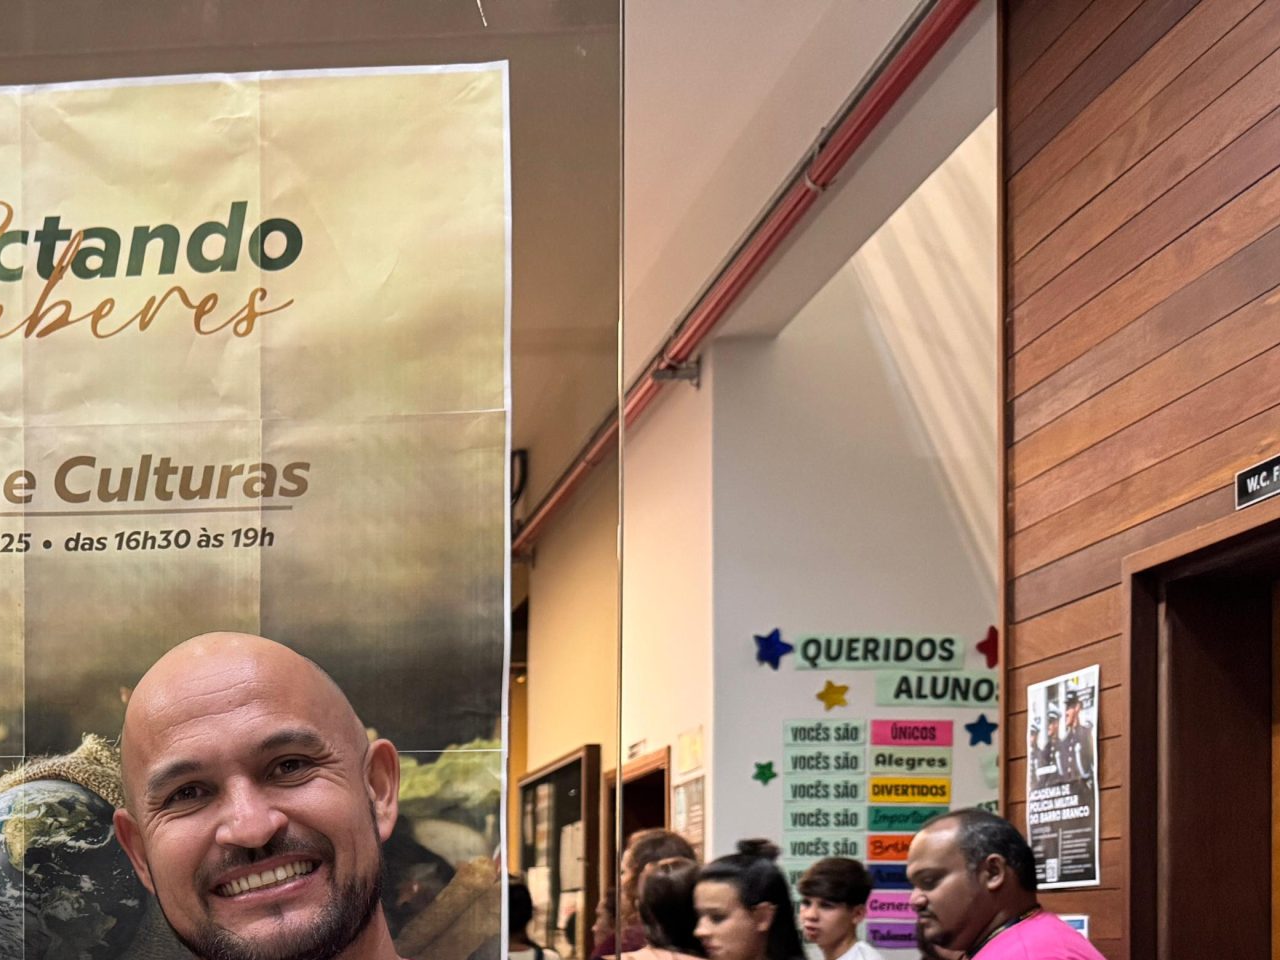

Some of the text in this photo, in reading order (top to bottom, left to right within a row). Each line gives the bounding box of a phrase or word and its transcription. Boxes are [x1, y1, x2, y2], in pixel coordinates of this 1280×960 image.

[3, 468, 37, 504] e
[54, 454, 311, 503] Culturas
[64, 531, 107, 553] das
[115, 529, 192, 552] 16h30
[196, 527, 225, 550] às
[231, 526, 275, 549] 19h
[801, 637, 955, 668] QUERIDOS
[894, 675, 999, 701] ALUNO
[790, 722, 829, 741] VOCÊS
[833, 723, 858, 740] SÃO
[790, 751, 947, 771] VOCÊS SÃO Alegres
[790, 780, 946, 799] VOCÊS SÃO DIVERTIDOS
[790, 809, 829, 827] VOCÊS
[833, 810, 858, 826] SÃO
[790, 838, 829, 856] VOCÊS
[833, 839, 858, 855] SÃO
